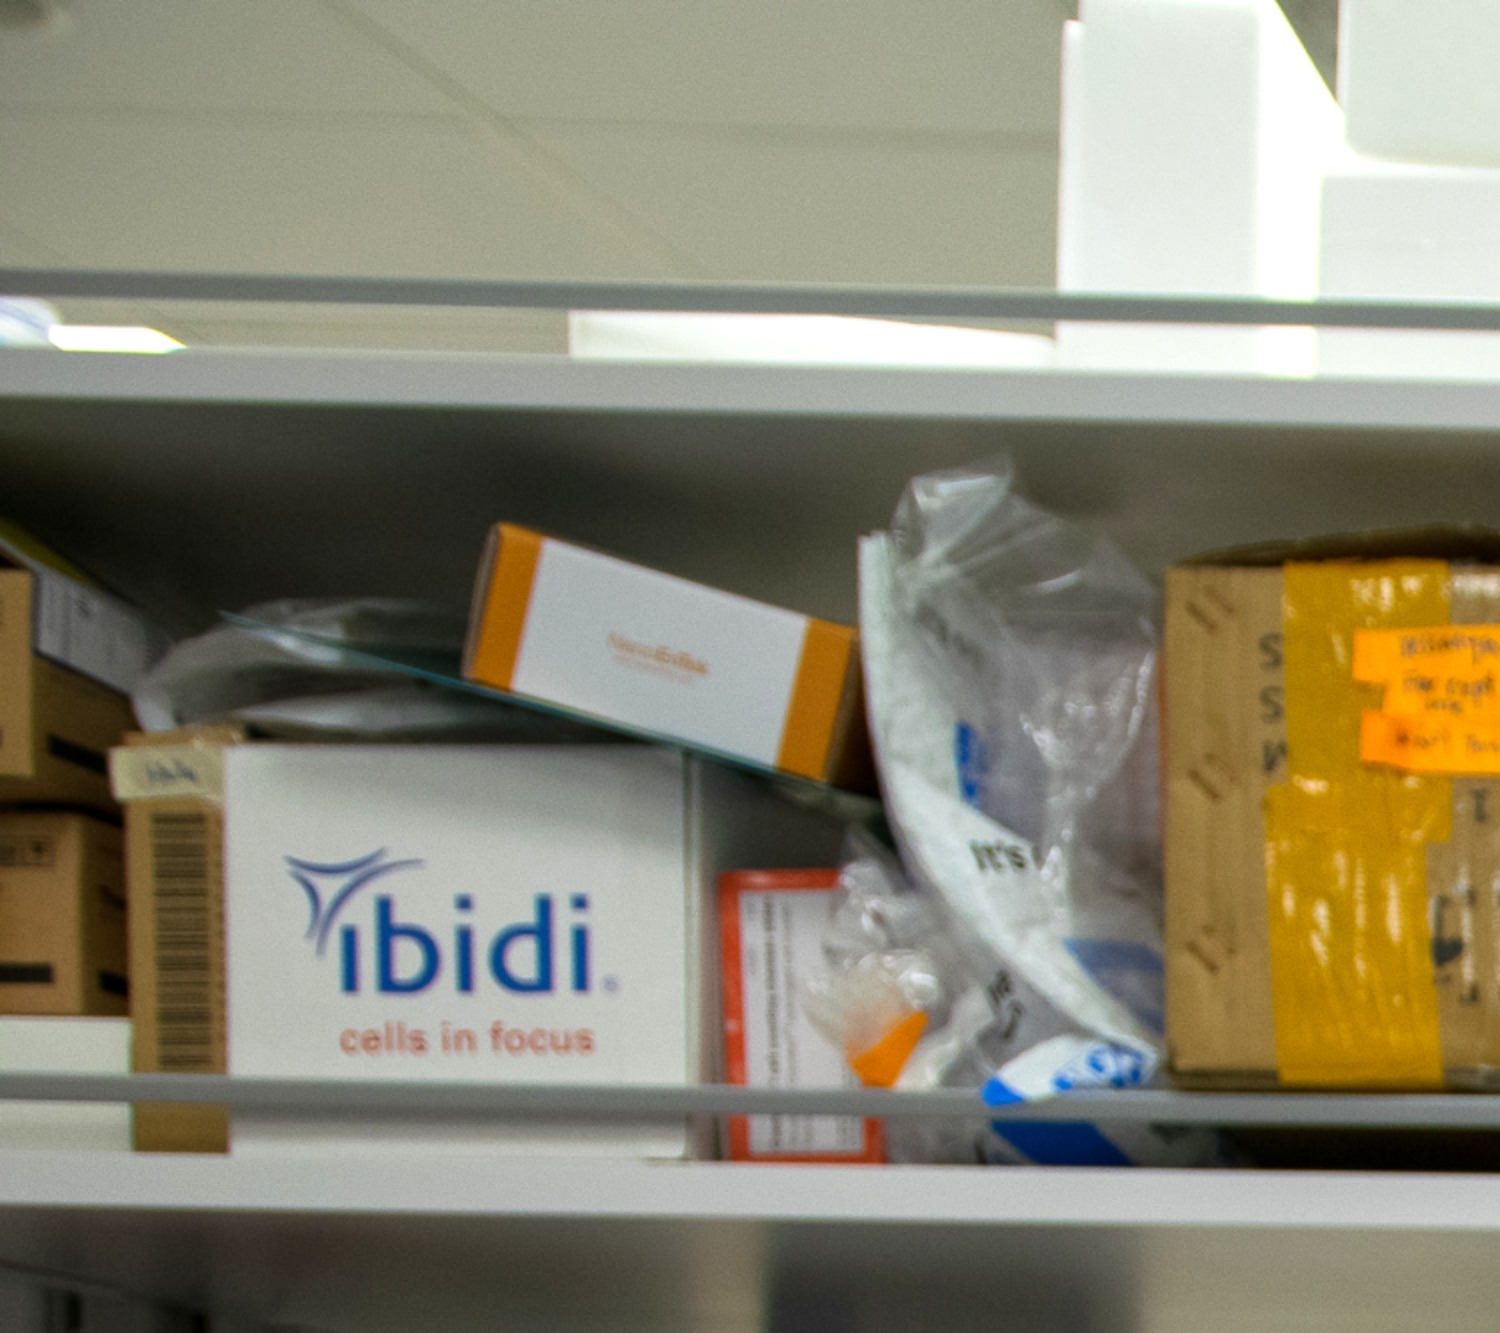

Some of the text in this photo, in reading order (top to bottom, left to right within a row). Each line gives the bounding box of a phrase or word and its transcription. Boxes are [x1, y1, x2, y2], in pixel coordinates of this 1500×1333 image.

[339, 1019, 597, 1056] cells in focus
